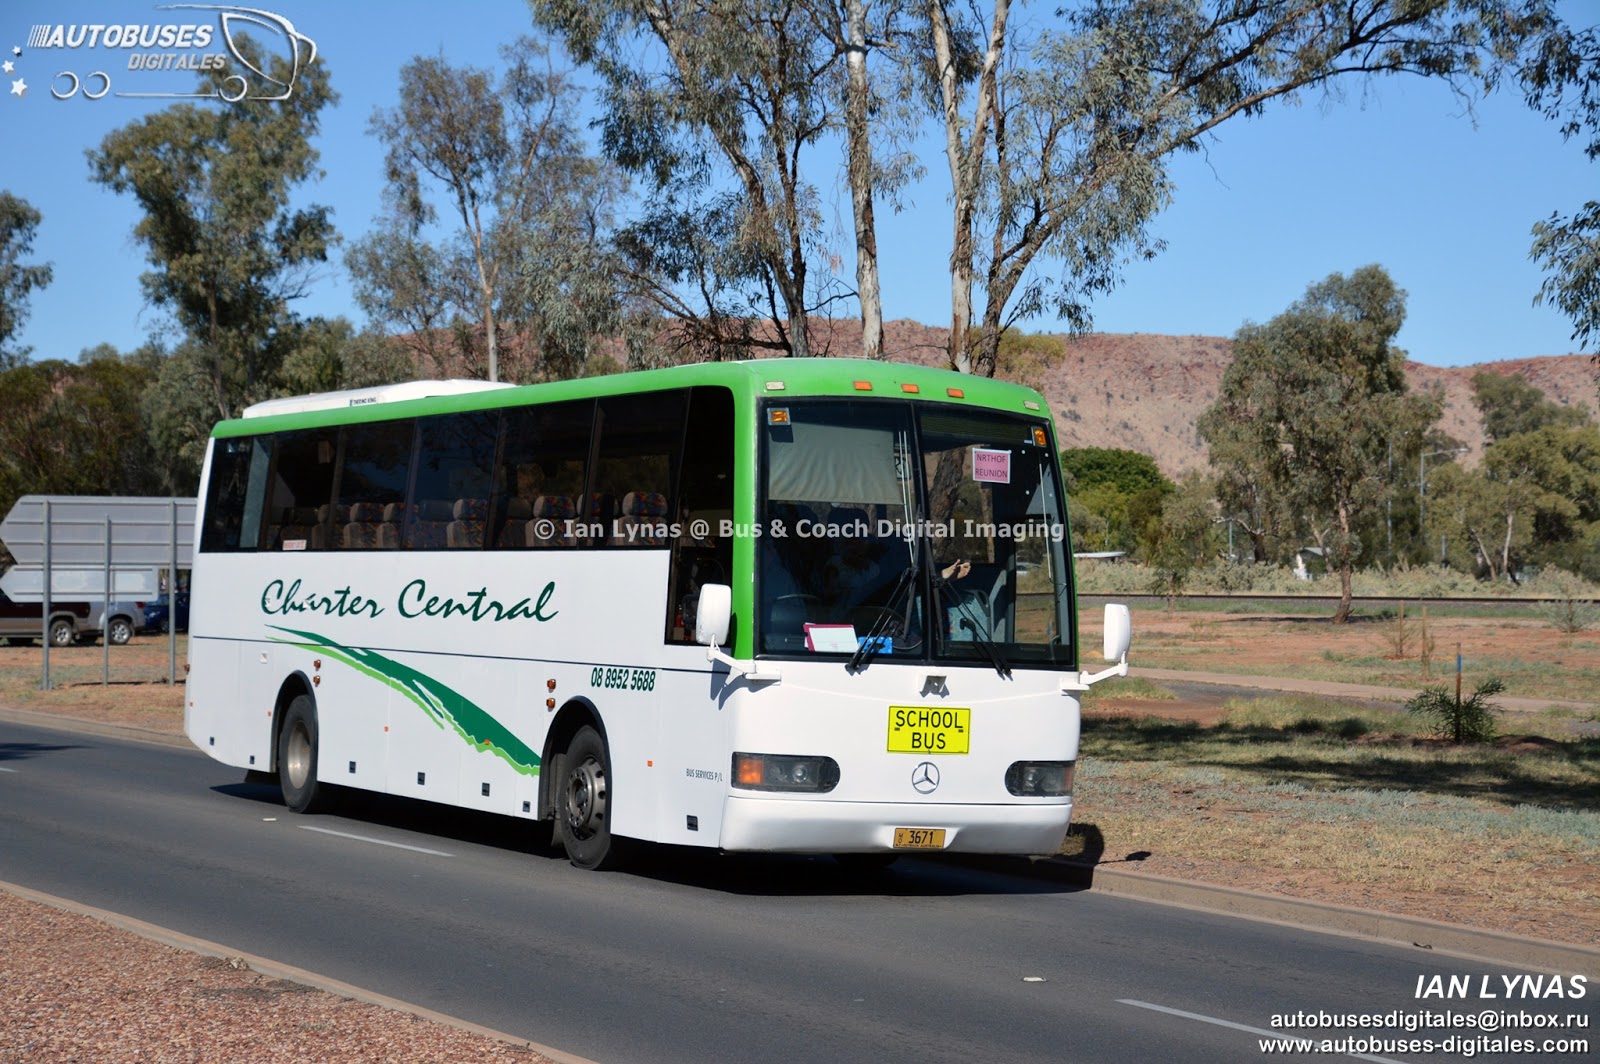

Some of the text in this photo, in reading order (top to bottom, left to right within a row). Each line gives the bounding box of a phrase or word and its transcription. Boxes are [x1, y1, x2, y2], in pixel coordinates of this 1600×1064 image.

[975, 468, 1008, 478] REUNION
[261, 579, 559, 622] Charter Central
[591, 667, 656, 691] 08 8952 5688
[895, 710, 963, 728] SCHOOL
[911, 732, 946, 750] BUS
[686, 768, 695, 777] BUS
[695, 769, 714, 781] SERVICES
[908, 830, 934, 844] 3671
